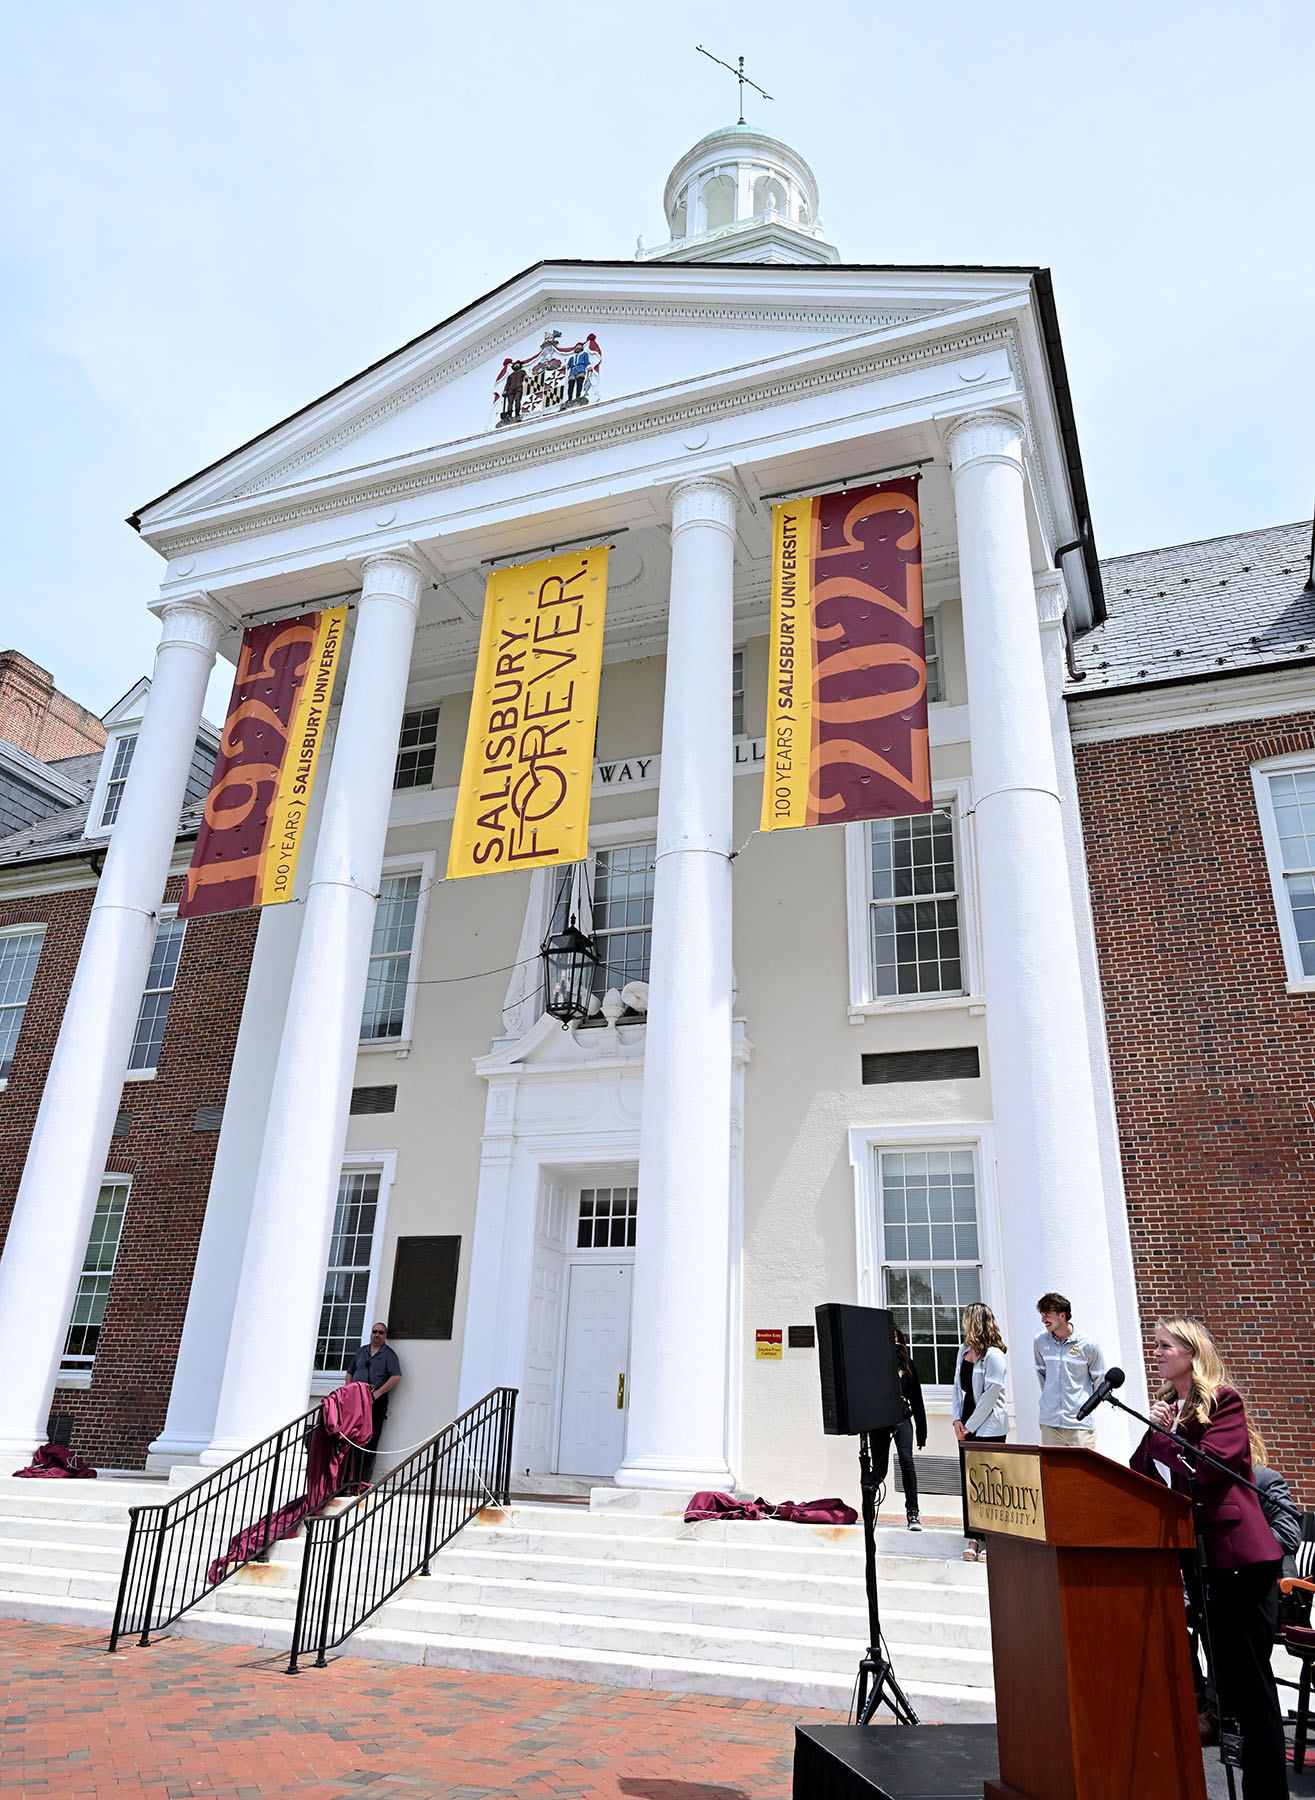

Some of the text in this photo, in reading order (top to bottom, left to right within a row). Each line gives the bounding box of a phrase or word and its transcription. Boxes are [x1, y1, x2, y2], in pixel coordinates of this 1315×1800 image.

[274, 617, 342, 893] 100 YEARS SALISBURY UNIVERSITY
[472, 618, 531, 865] SALISBURY.
[591, 759, 652, 783] WAY
[774, 514, 798, 818] 100 YEARS SALISBURY UNIVERSITY
[807, 491, 931, 814] 2025
[969, 1463, 1039, 1525] Salisbury
[979, 1506, 1031, 1526] UNIVERSITY
